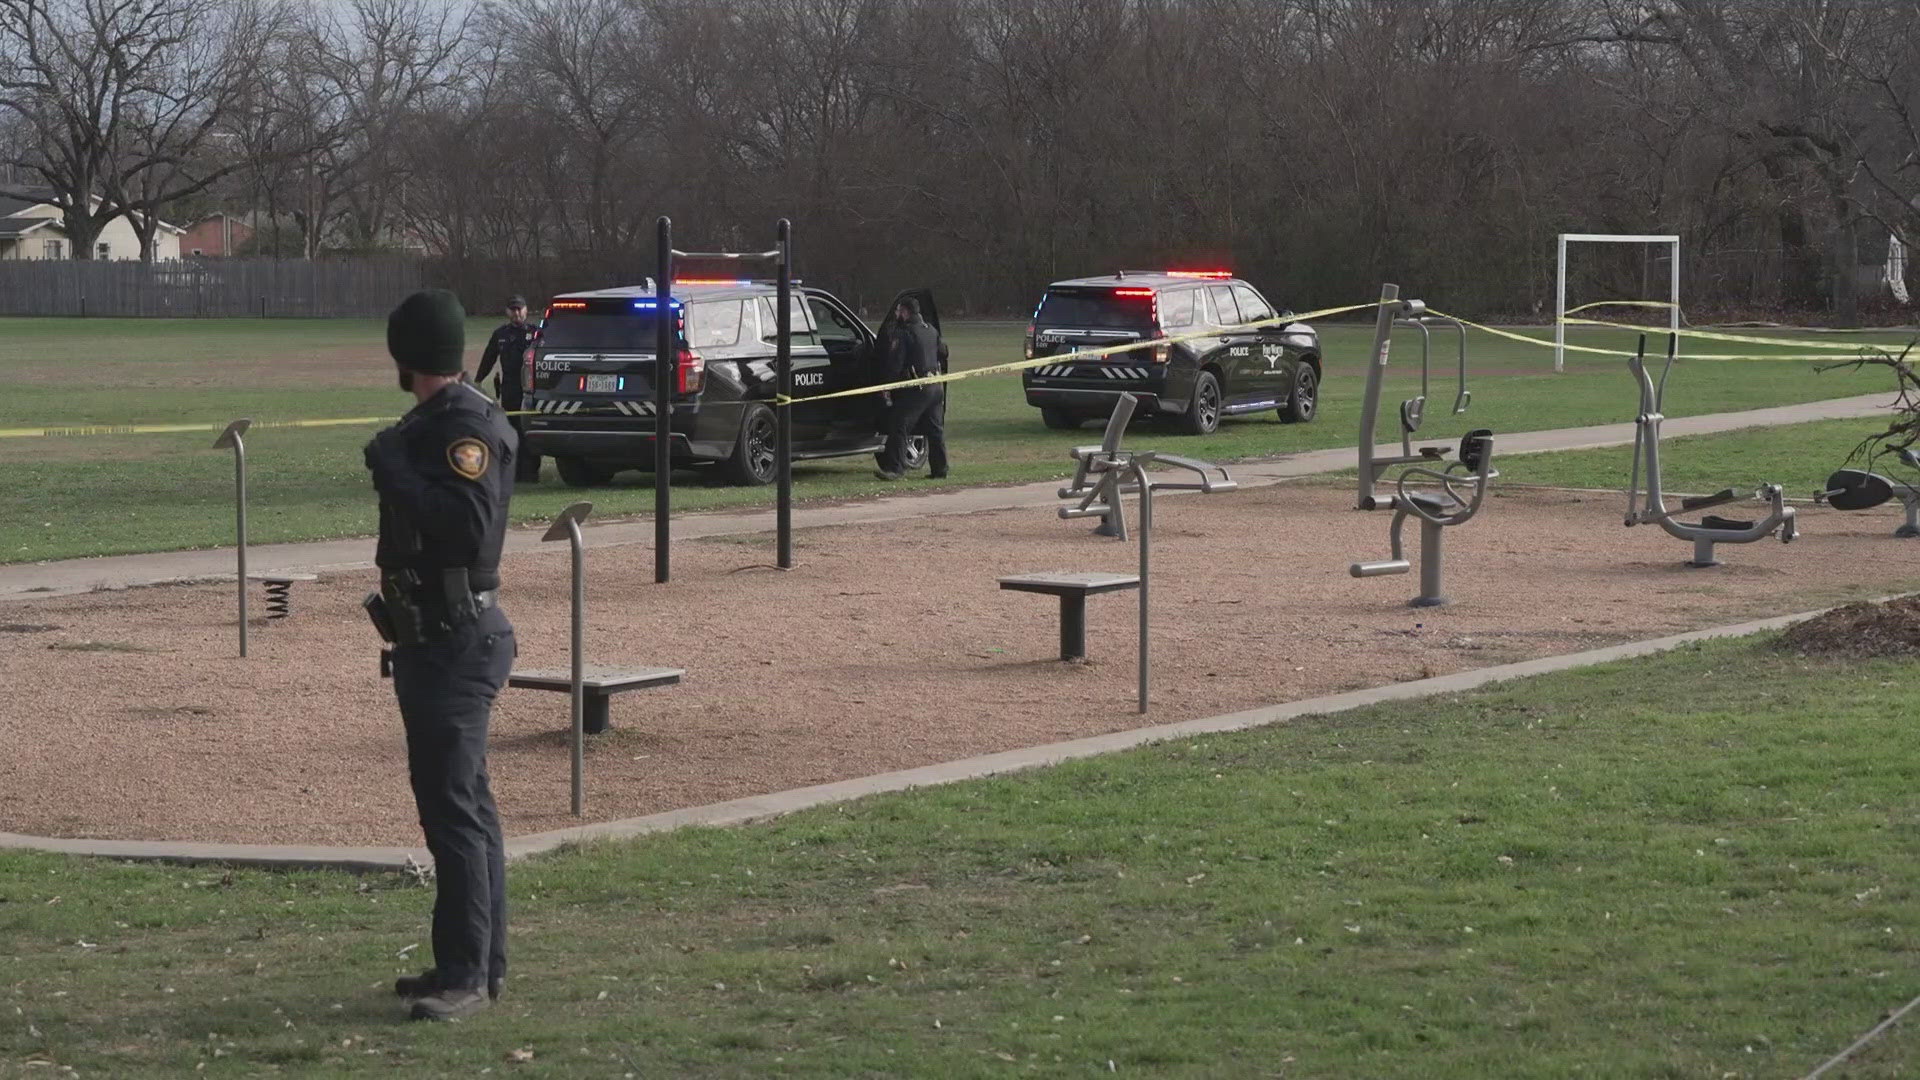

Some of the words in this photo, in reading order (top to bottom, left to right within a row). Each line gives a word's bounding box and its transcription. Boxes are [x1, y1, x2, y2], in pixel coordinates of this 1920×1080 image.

[1035, 334, 1066, 343] POLICE
[1230, 346, 1249, 357] POLICE
[535, 361, 571, 371] POLICE
[794, 372, 824, 386] POLICE
